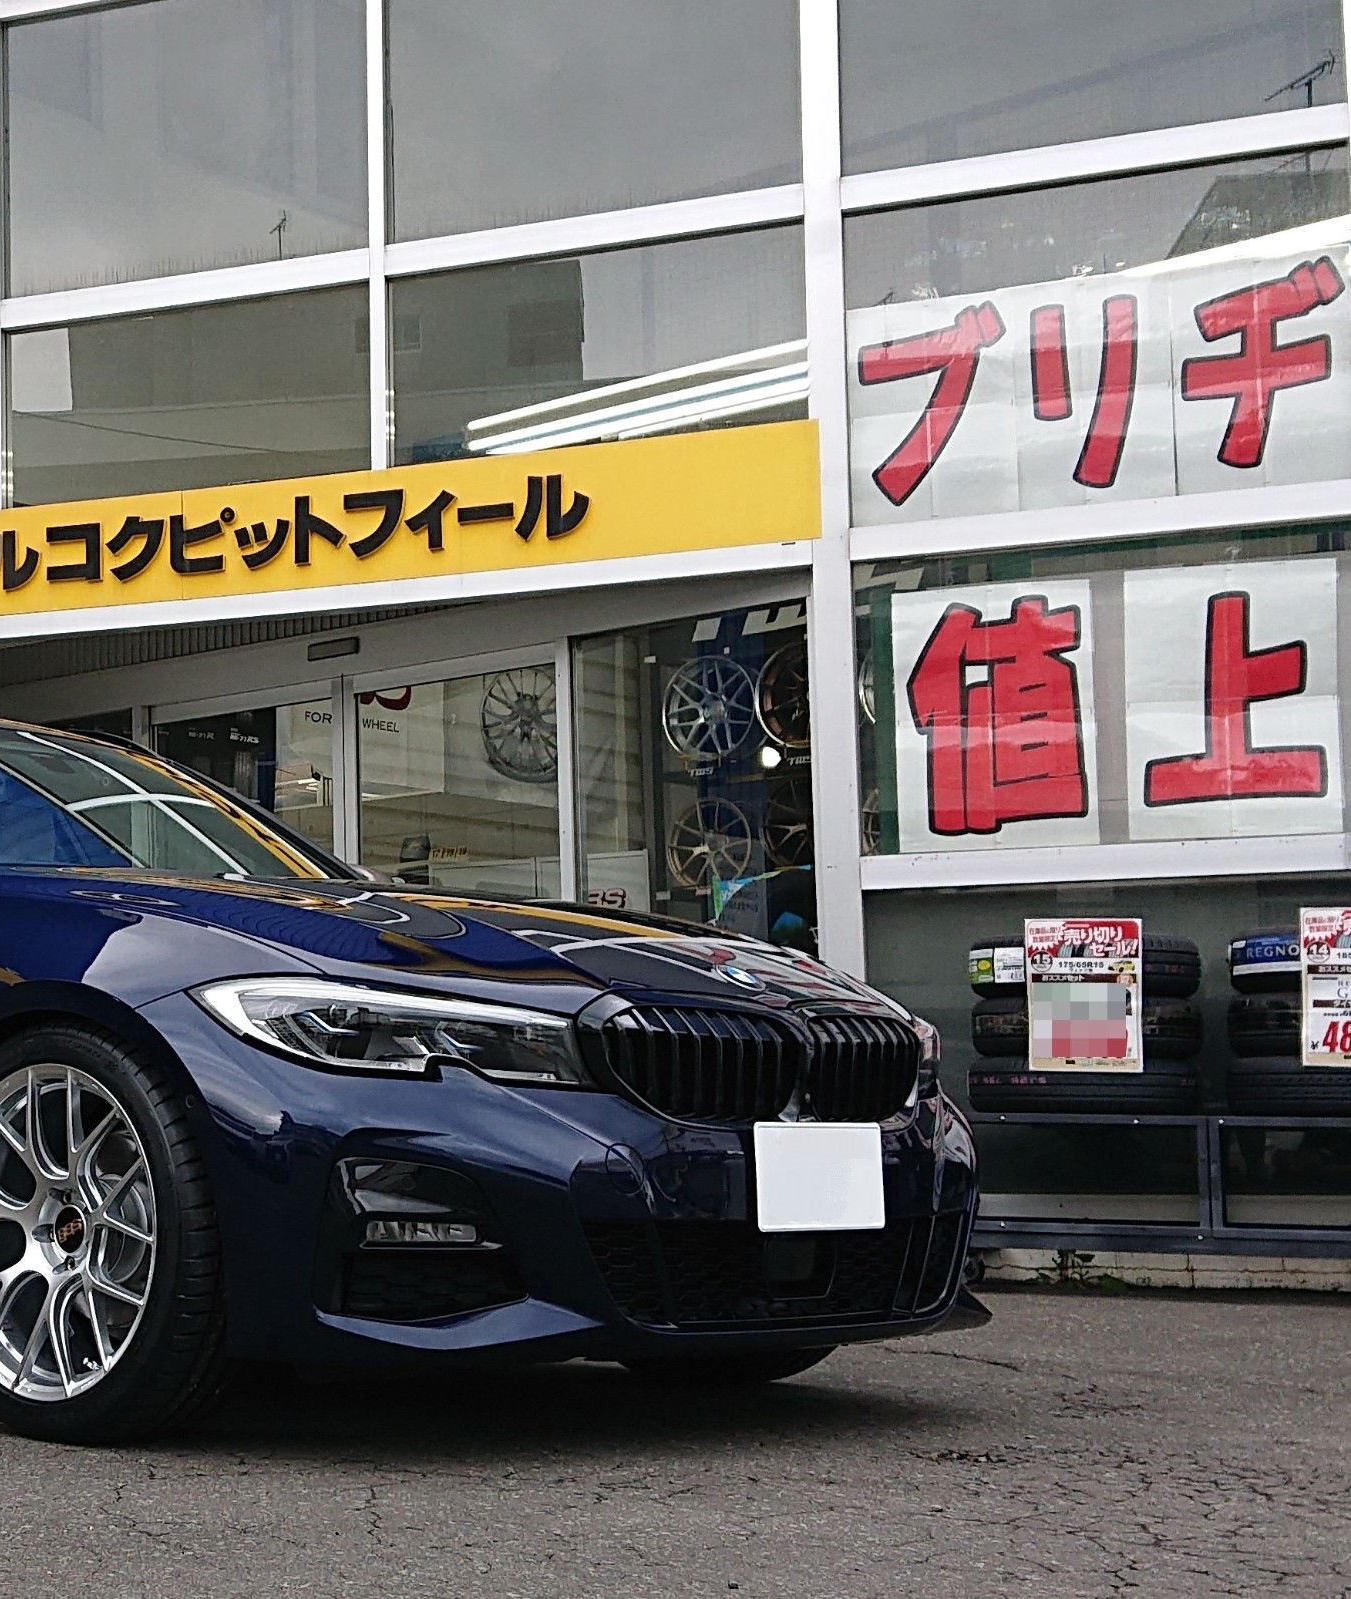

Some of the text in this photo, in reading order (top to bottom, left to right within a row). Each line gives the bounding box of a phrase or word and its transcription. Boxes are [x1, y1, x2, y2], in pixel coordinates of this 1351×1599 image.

[304, 711, 399, 733] FOR WHEEL
[906, 594, 1328, 835] 値上
[1063, 926, 1123, 945] 売り切り
[1246, 944, 1300, 959] REGNO
